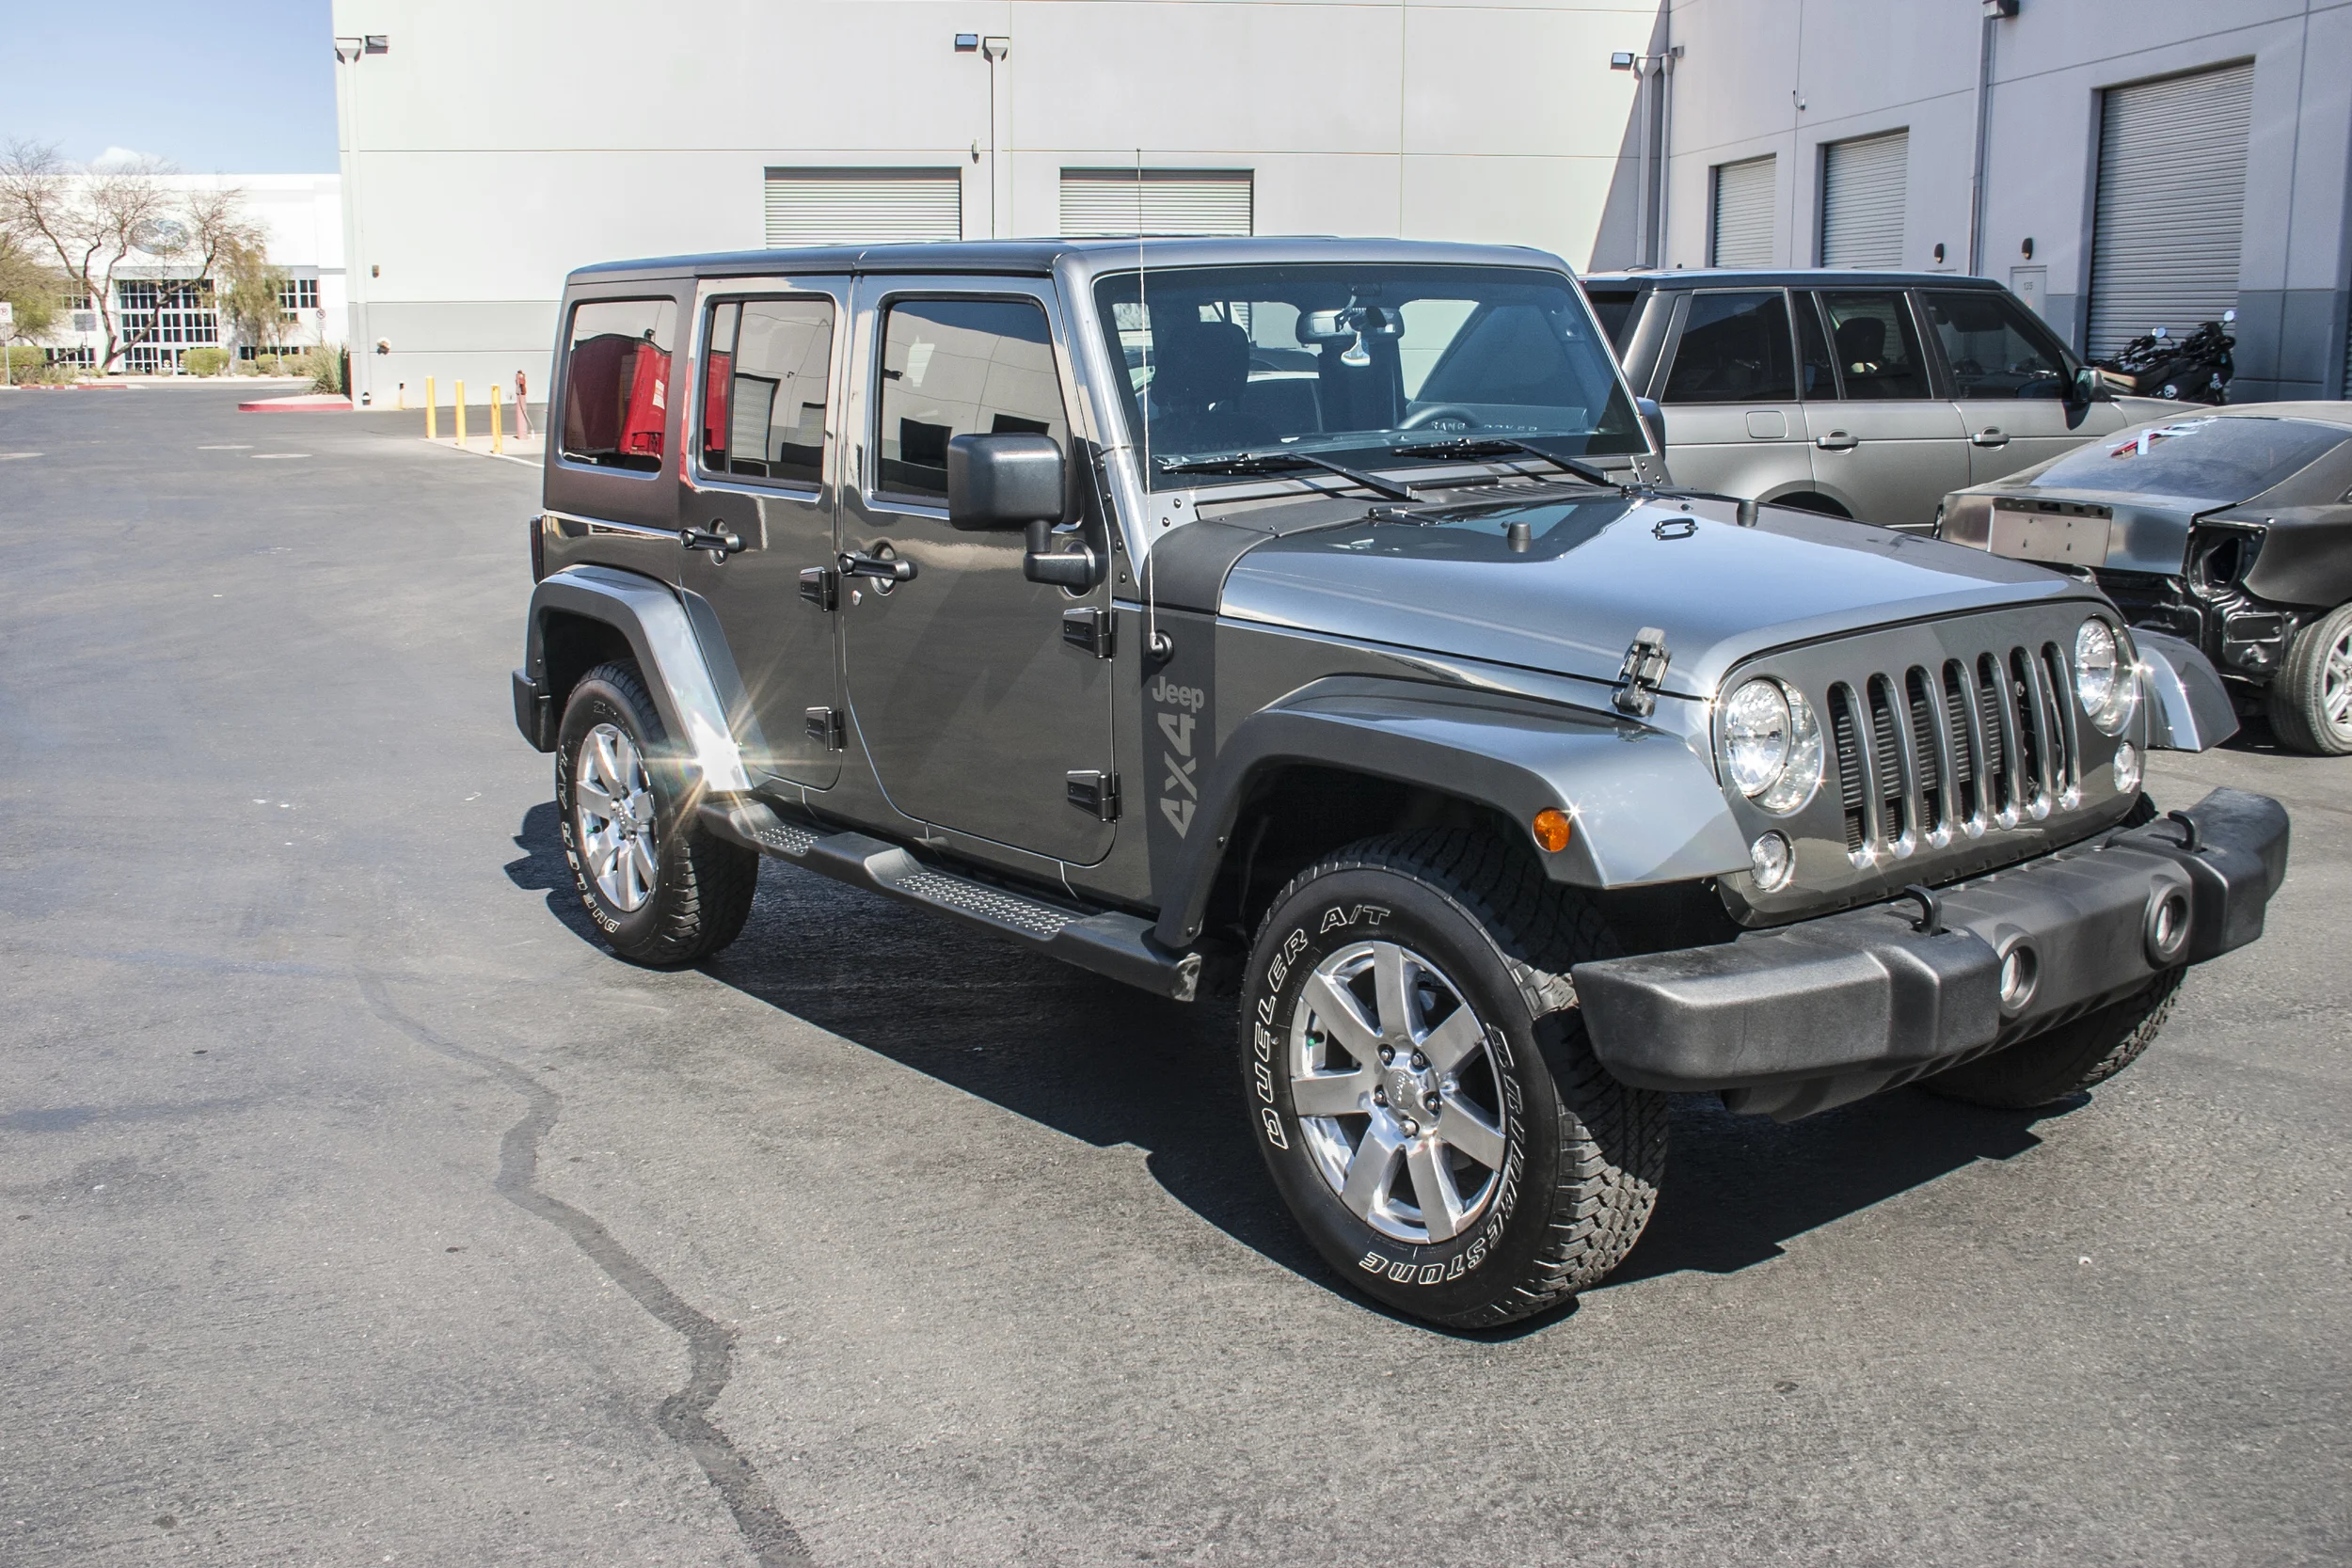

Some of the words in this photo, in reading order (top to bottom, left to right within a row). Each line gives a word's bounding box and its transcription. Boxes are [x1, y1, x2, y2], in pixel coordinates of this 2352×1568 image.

[1152, 675, 1204, 713] Jeep
[1157, 712, 1198, 840] 4X4
[1254, 927, 1309, 1150] DUELER
[1320, 904, 1391, 934] A/T
[1359, 1022, 1526, 1285] BRIDGESTONE
